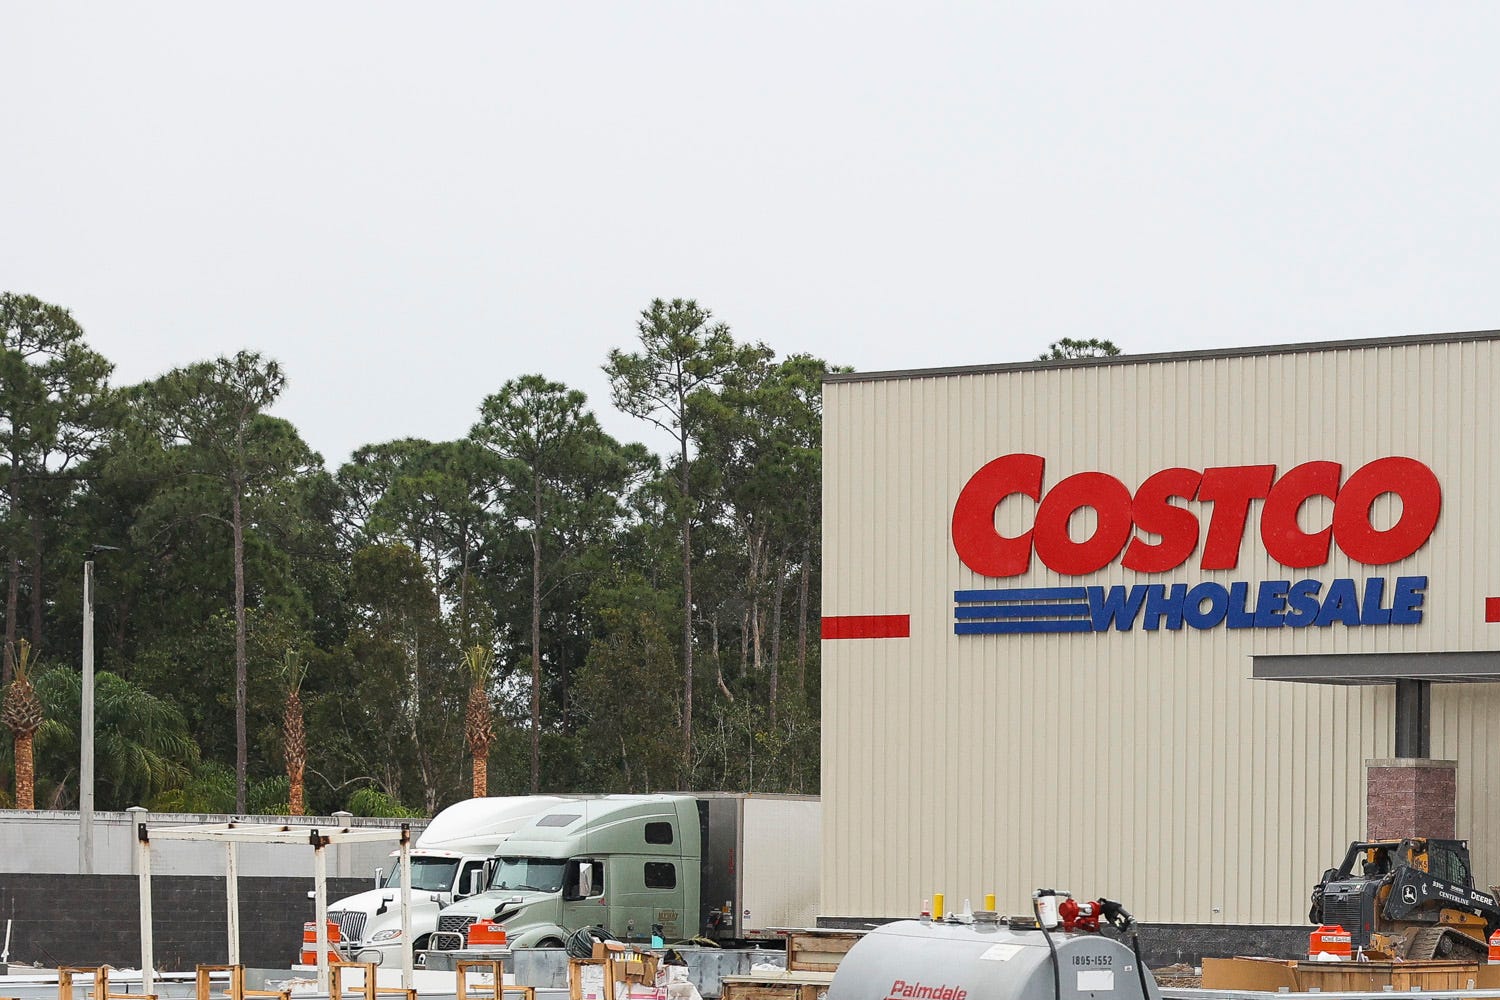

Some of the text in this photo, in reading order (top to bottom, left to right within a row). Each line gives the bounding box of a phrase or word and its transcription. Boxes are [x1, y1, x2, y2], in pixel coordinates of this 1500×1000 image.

[951, 453, 1442, 578] COSTCO
[1086, 576, 1428, 632] WHOLESALE
[1439, 890, 1469, 906] CENTERLINE
[1470, 891, 1493, 906] DEERE
[890, 980, 968, 1000] Palmdale
